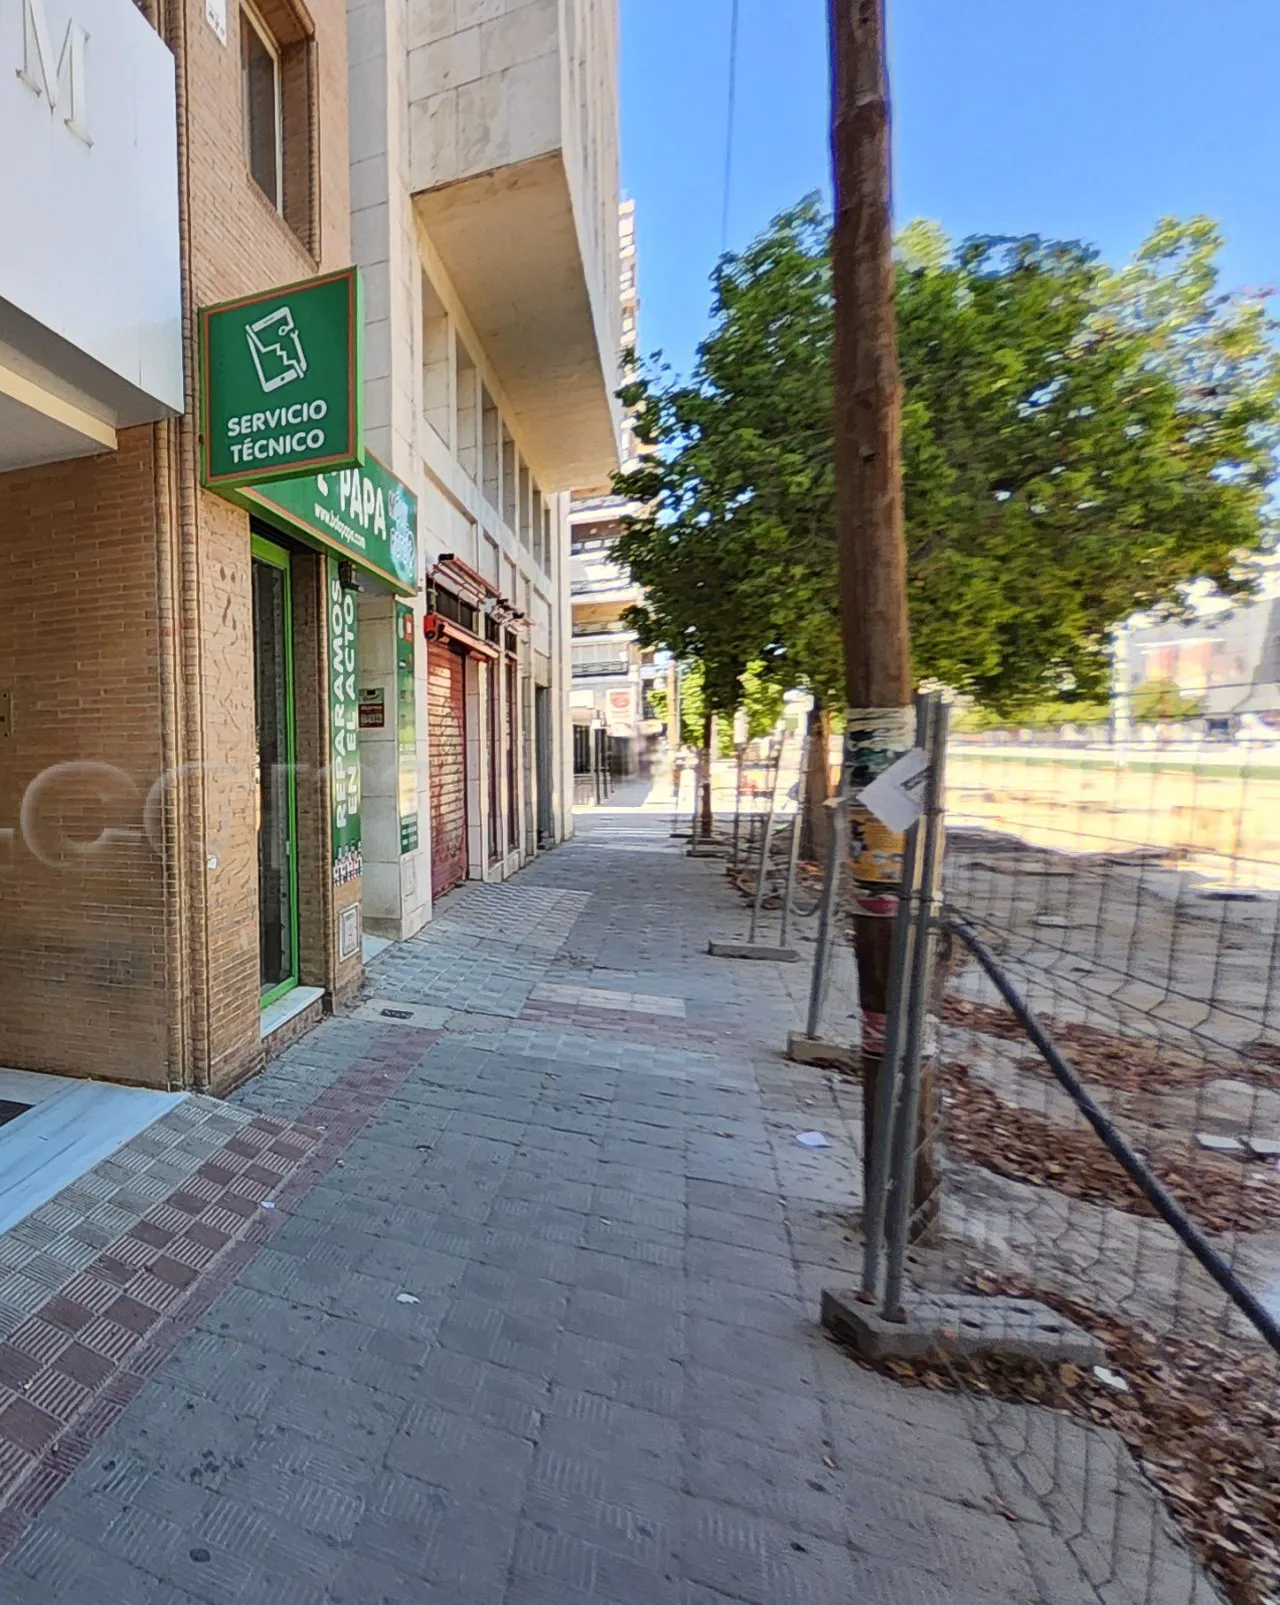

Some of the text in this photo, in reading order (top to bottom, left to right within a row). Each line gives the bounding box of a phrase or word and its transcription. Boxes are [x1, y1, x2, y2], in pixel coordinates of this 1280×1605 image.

[227, 399, 328, 437] SERVICIO
[230, 428, 325, 464] TÉCNICO
[340, 467, 387, 541] PAPA
[332, 579, 347, 828] REPARAMOS
[344, 594, 358, 815] EN EL ACTO
